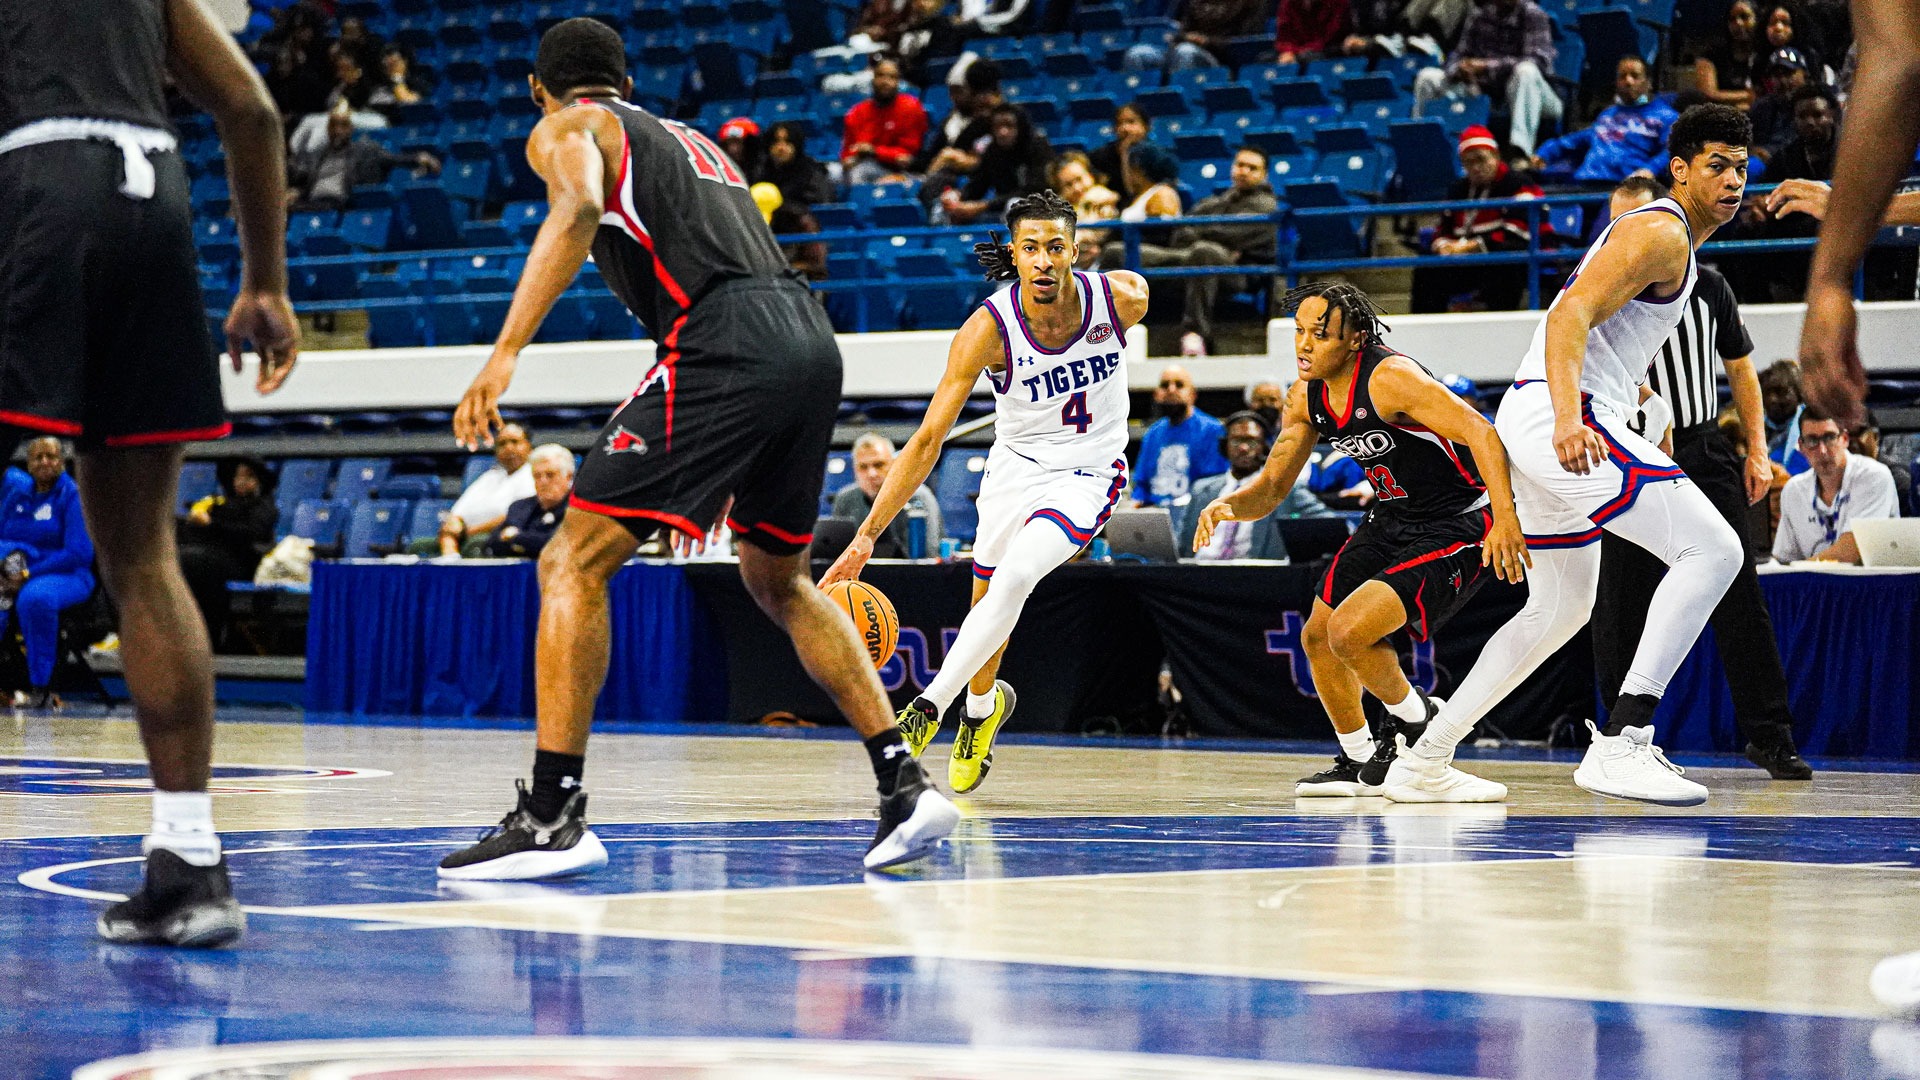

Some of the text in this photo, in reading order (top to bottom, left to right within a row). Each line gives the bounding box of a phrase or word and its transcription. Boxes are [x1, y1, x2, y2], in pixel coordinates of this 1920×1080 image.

[1091, 327, 1110, 341] OVC
[1022, 352, 1119, 402] TIGERS
[1061, 391, 1093, 434] 4
[1365, 464, 1409, 501] 12
[862, 600, 882, 663] Wilson
